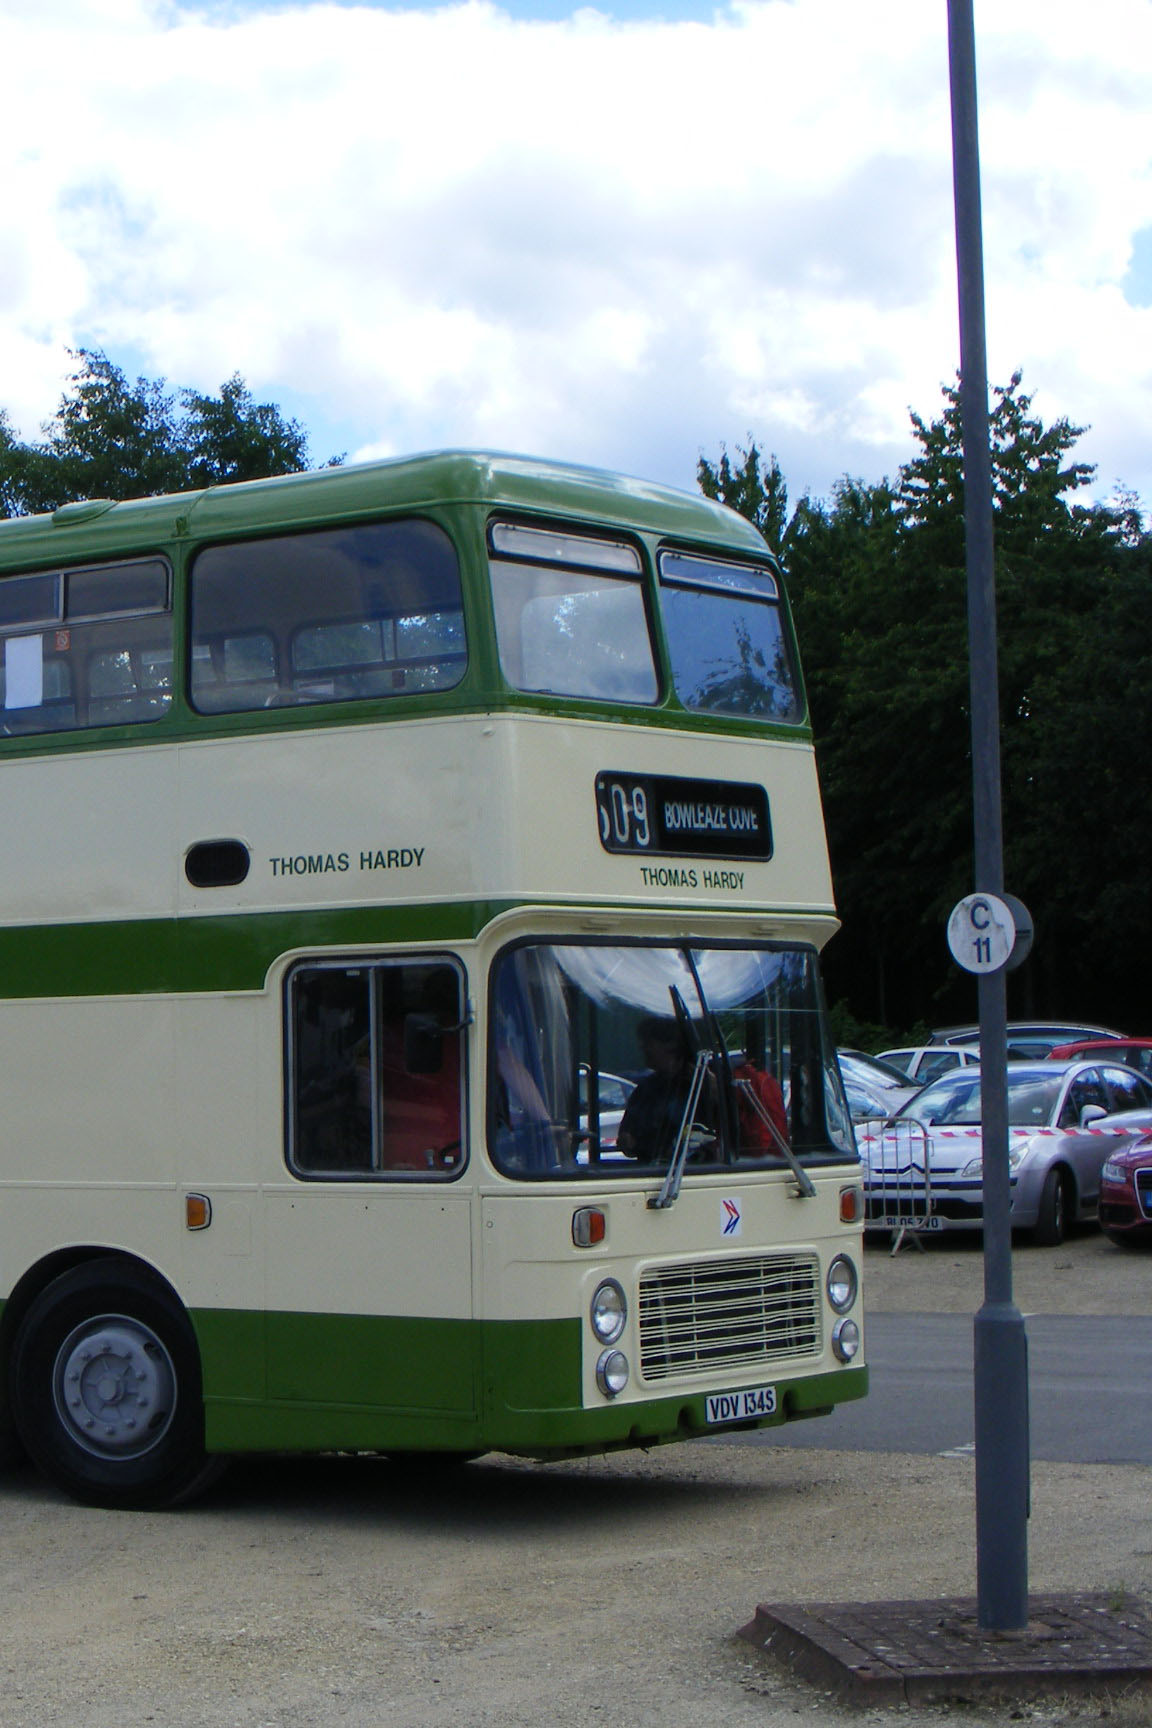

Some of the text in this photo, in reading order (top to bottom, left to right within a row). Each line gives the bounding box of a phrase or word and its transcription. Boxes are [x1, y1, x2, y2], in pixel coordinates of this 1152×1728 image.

[664, 800, 727, 830] BOWLEAZE
[269, 847, 426, 876] THOMAS HARDY
[640, 867, 745, 889] THOMAS HARDY
[970, 902, 990, 930] C
[972, 937, 991, 963] 11
[710, 1390, 774, 1420] VDV 134S
